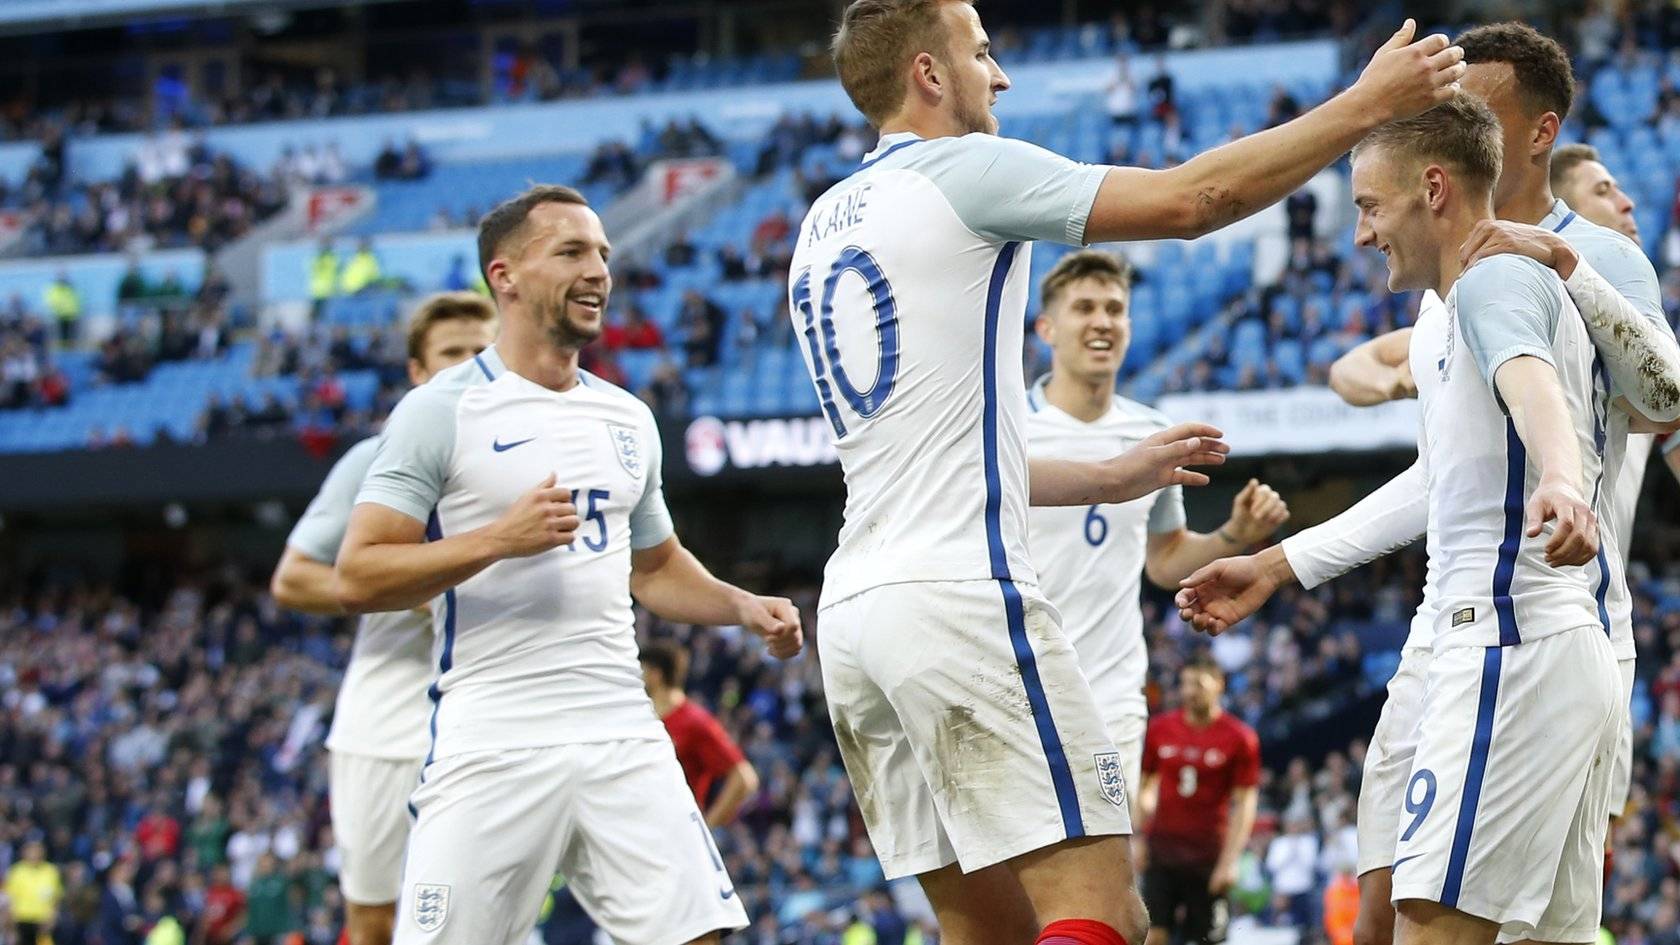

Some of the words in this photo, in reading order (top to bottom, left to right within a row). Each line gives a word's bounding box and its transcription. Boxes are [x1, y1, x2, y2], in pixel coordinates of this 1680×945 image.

[807, 185, 872, 247] KANE
[792, 244, 900, 440] 10
[1084, 504, 1108, 547] 6
[1399, 768, 1438, 842] 9
